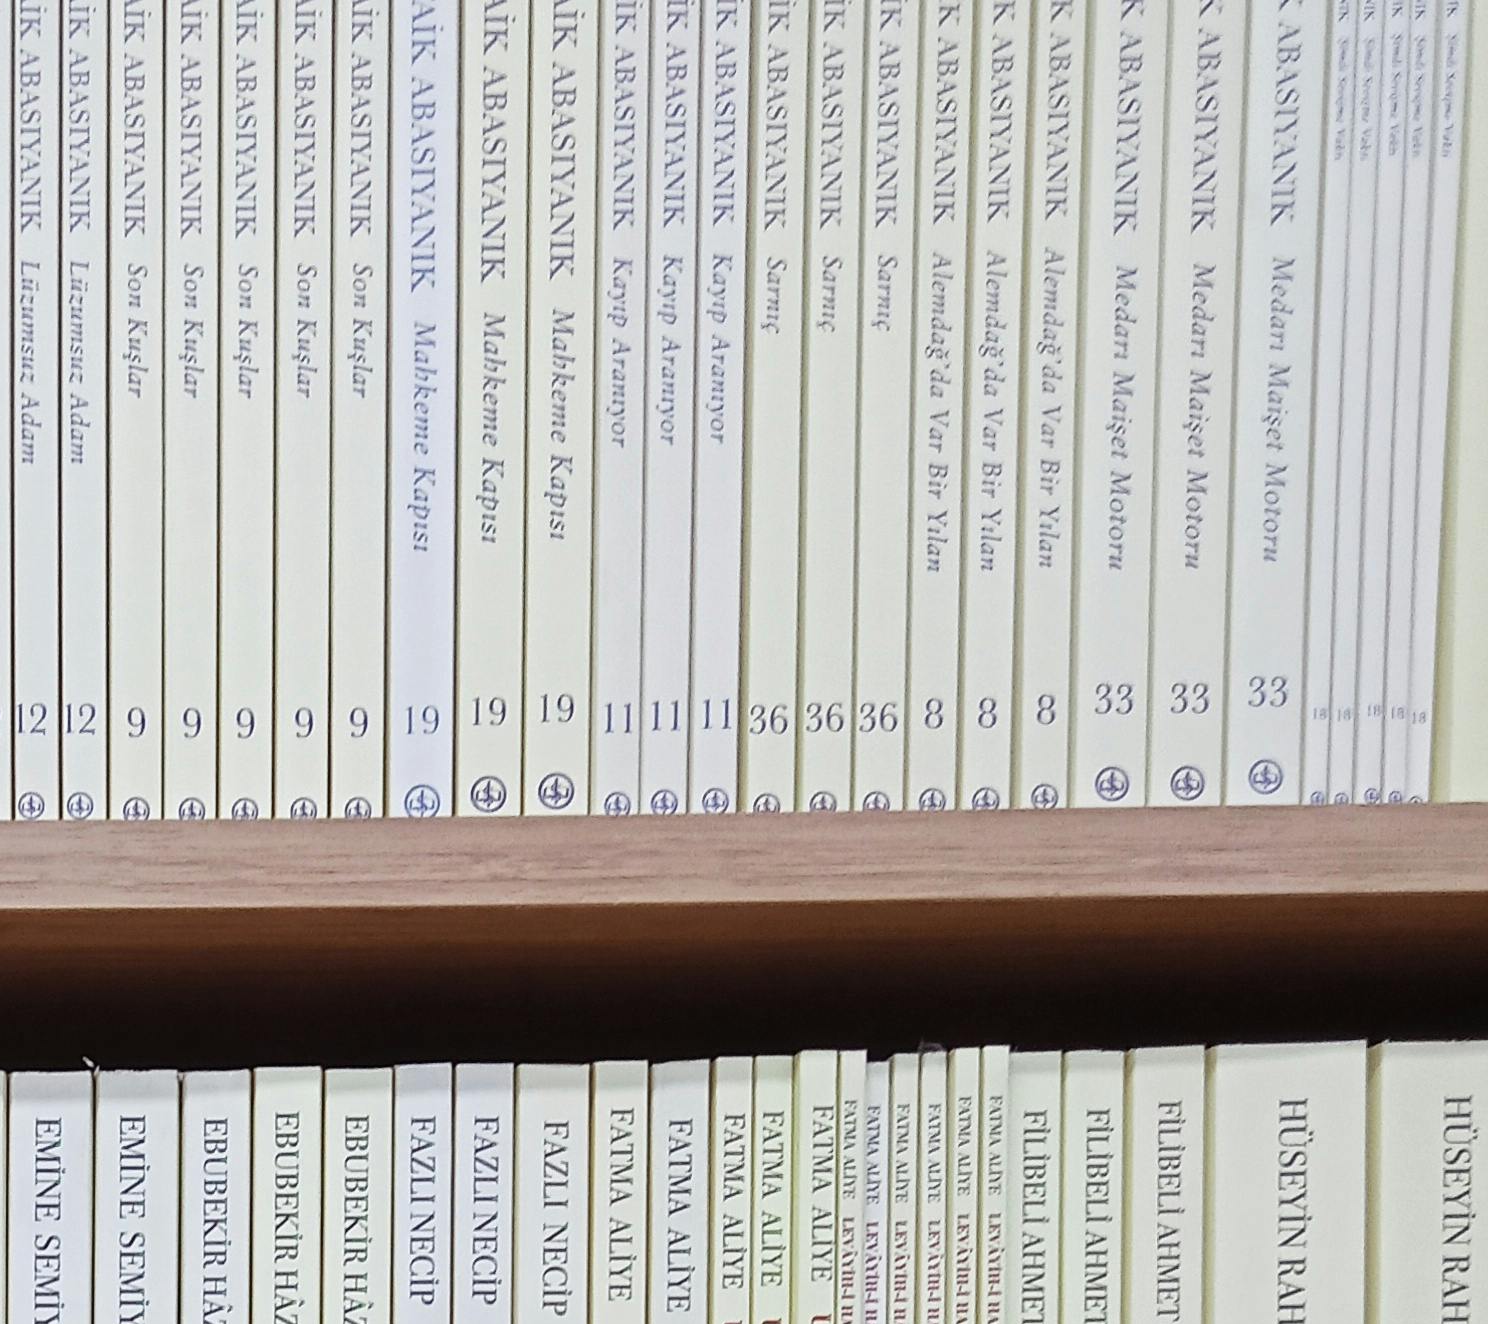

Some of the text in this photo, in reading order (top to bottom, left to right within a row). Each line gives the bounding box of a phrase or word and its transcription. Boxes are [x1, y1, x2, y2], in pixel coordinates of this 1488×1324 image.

[123, 51, 146, 239] ABASIYANIK
[932, 35, 960, 225] ABASIYANIK
[121, 317, 150, 399] Kuşlar
[406, 75, 438, 553] ABASIYANIK Mahkeme Kapısı
[1105, 30, 1144, 571] ABASIYANIK Medarı Maişet Motoru
[926, 509, 949, 573] Yılan
[126, 706, 147, 739] 9
[406, 704, 440, 735] 19
[924, 697, 945, 730] 8
[1094, 682, 1134, 716] 33
[273, 1110, 304, 1265] EBUBEKİR
[1276, 1097, 1315, 1249] HÜSEYİN
